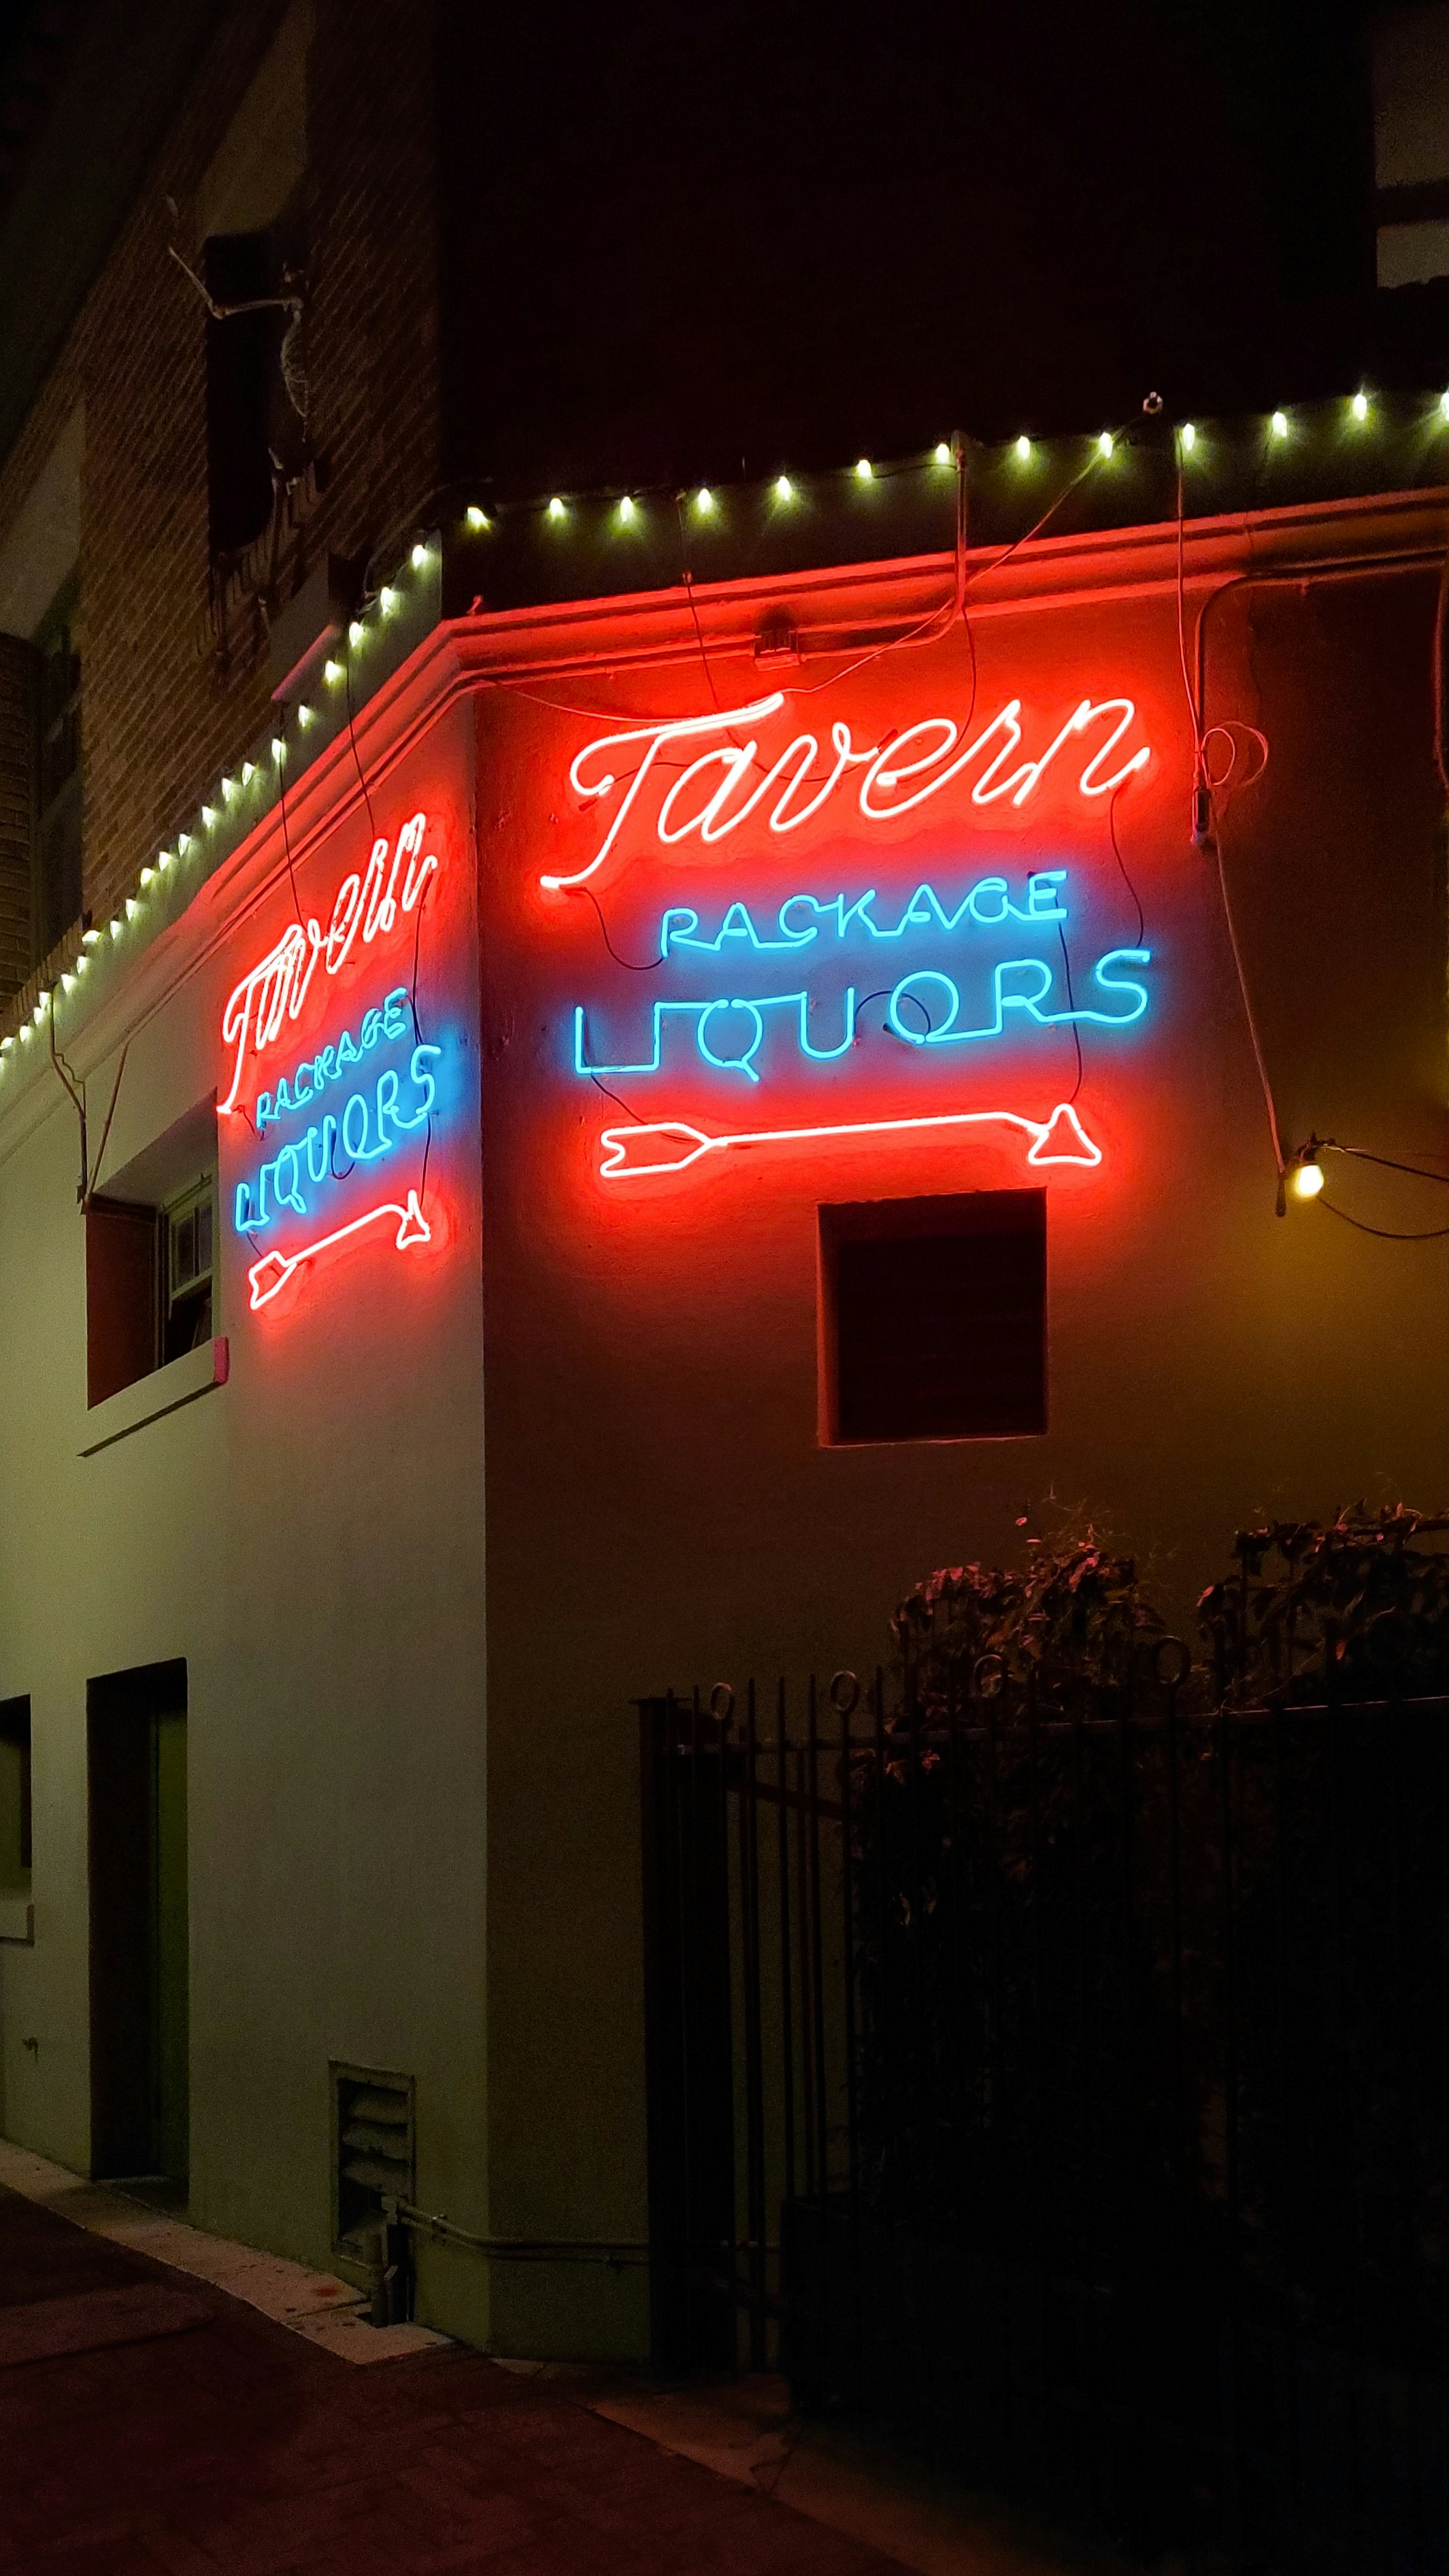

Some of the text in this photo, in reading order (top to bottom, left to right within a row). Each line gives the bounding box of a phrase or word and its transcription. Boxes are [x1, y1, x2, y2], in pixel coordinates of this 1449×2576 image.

[542, 692, 1150, 888] Tavern
[216, 813, 437, 1114] Tavern
[661, 870, 1067, 957] PACKAGE
[255, 987, 409, 1131] PACKAGE
[575, 950, 1151, 1082] LIQUORS
[235, 1045, 442, 1233] LIQUORS
